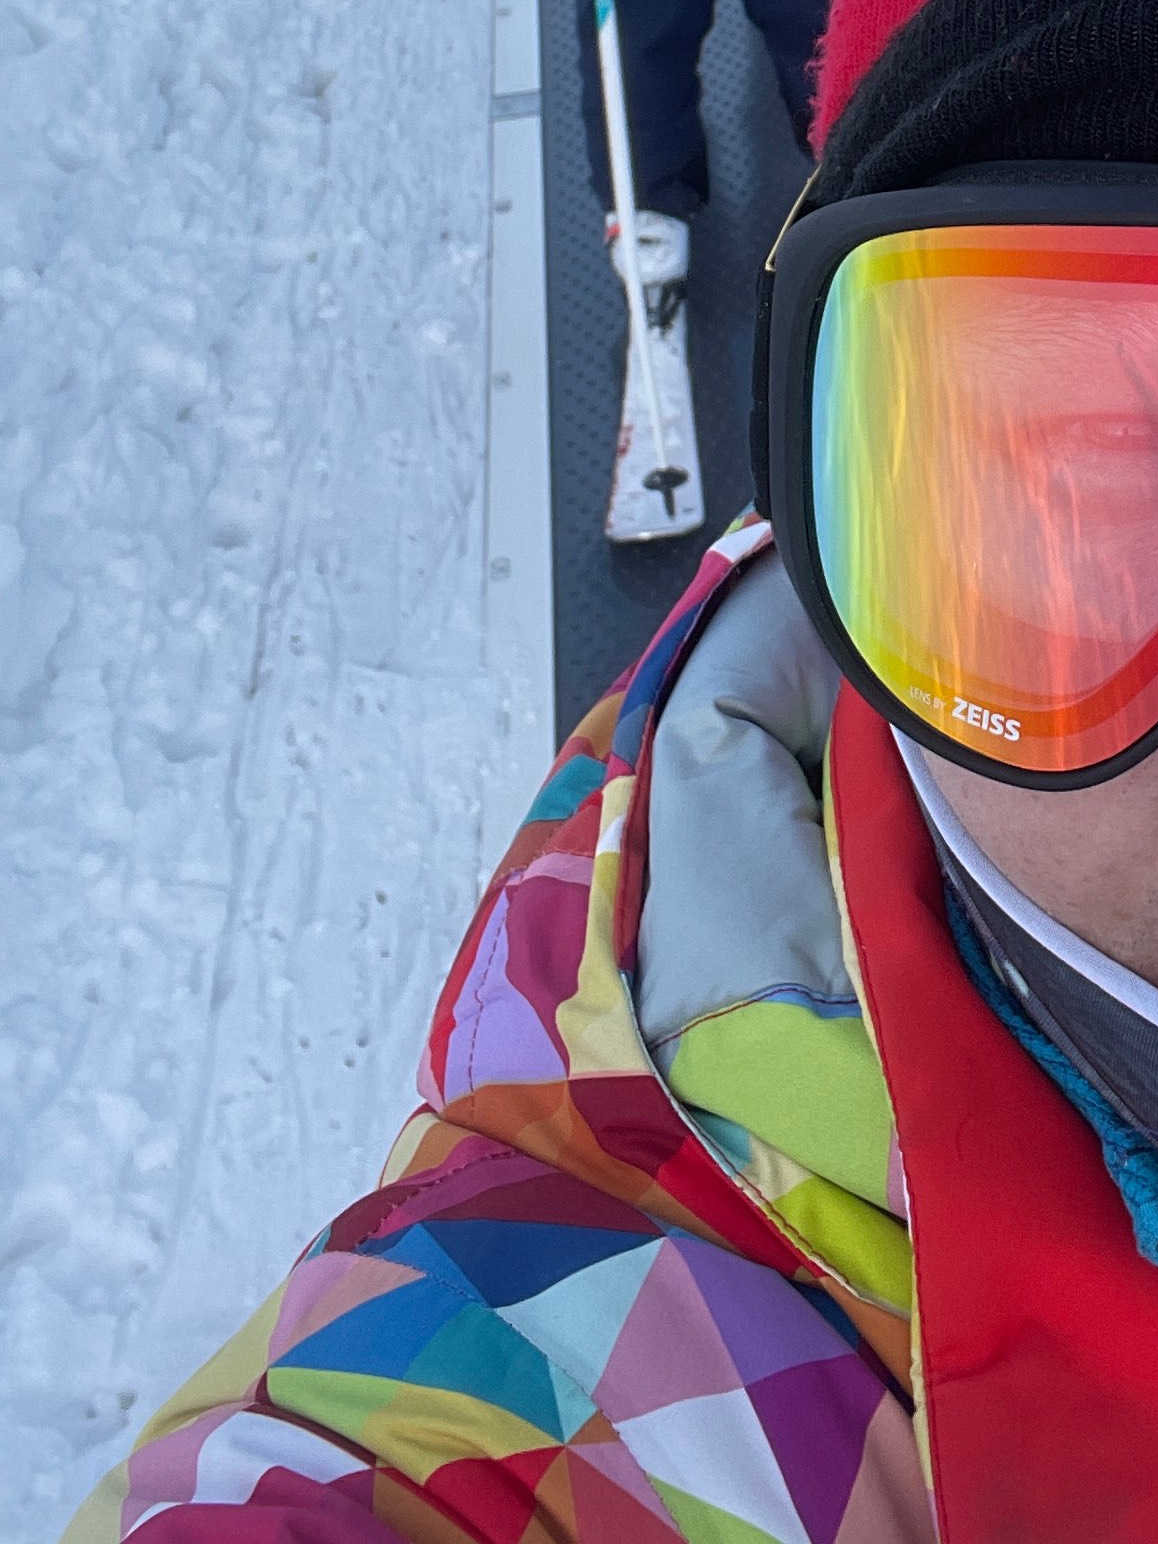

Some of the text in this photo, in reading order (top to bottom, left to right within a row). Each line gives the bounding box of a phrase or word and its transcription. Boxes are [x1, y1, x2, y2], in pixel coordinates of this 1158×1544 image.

[909, 685, 1021, 742] LENS BY ZEISS
